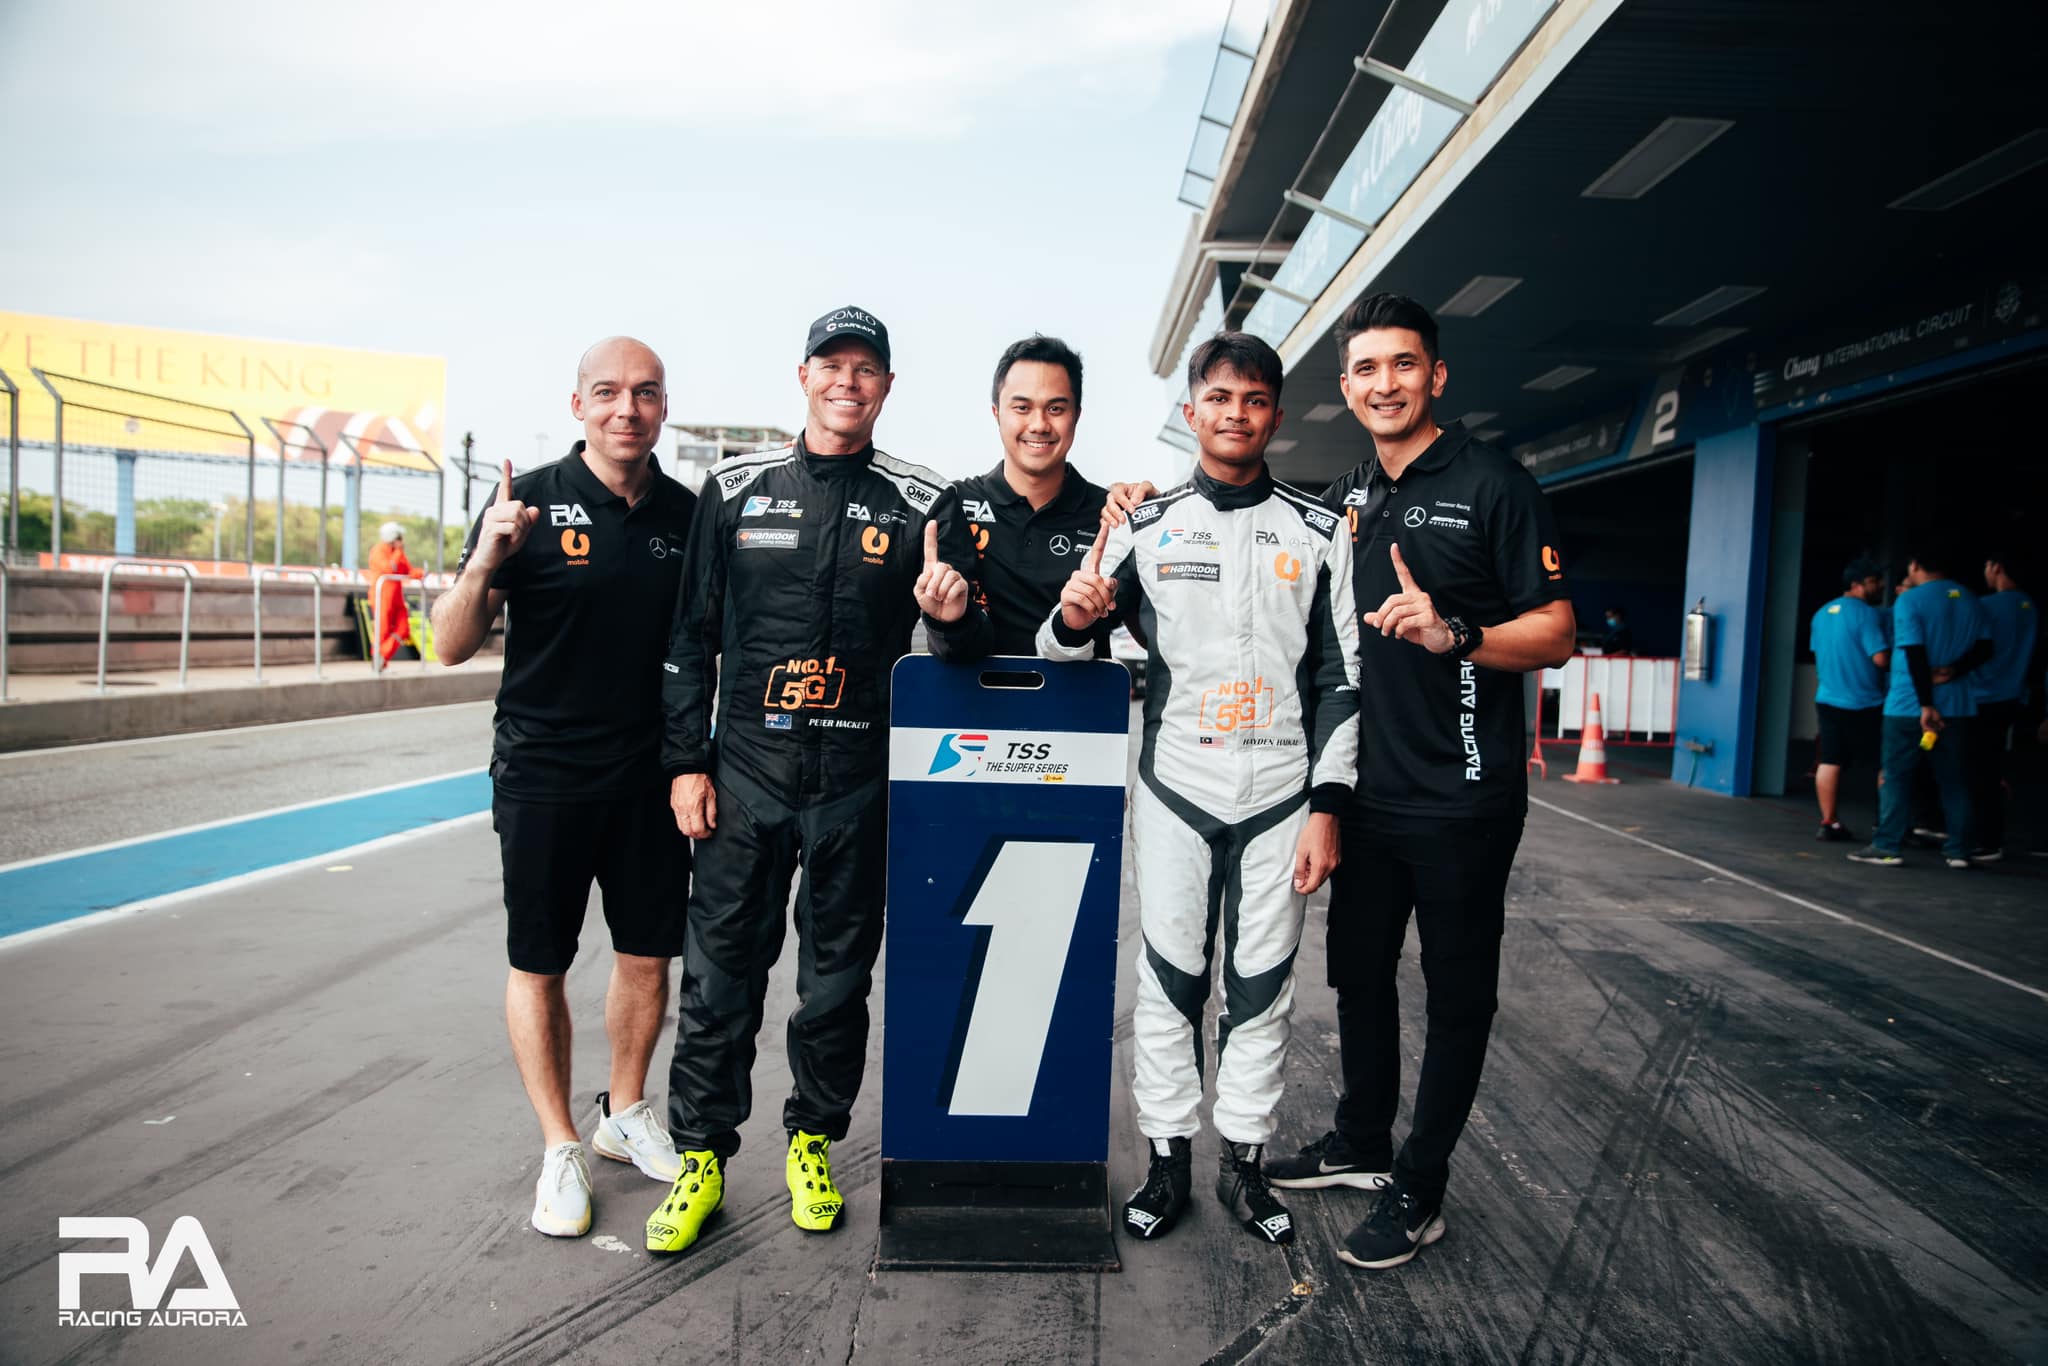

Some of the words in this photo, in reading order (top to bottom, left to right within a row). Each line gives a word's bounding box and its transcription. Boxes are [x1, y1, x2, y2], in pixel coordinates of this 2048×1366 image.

[1783, 353, 1820, 381] Chang
[1823, 324, 1911, 368] INTERNATIONAL
[1916, 304, 1975, 342] CIRCUIT
[69, 338, 176, 384] THE
[200, 351, 333, 397] KING
[1651, 390, 1680, 446] 2
[724, 471, 750, 488] OMP
[906, 485, 932, 503] OMP
[776, 500, 798, 509] TSS
[1131, 505, 1159, 521] OMP
[1305, 512, 1333, 528] OMP
[1192, 531, 1212, 540] TSS
[1255, 530, 1280, 544] RA
[786, 656, 836, 675] NO.1
[779, 674, 826, 711] 5G
[1218, 676, 1263, 696] NO.1
[1215, 696, 1257, 732] 5G
[809, 718, 834, 728] PETER
[835, 720, 871, 729] HACKETT
[1243, 737, 1274, 746] HAYDEN
[1460, 713, 1481, 781] RACING
[1007, 742, 1052, 760] TSS
[985, 762, 1004, 773] THE
[1005, 762, 1035, 773] SUPER
[1034, 763, 1069, 774] SERIES
[948, 841, 1096, 1117] 1
